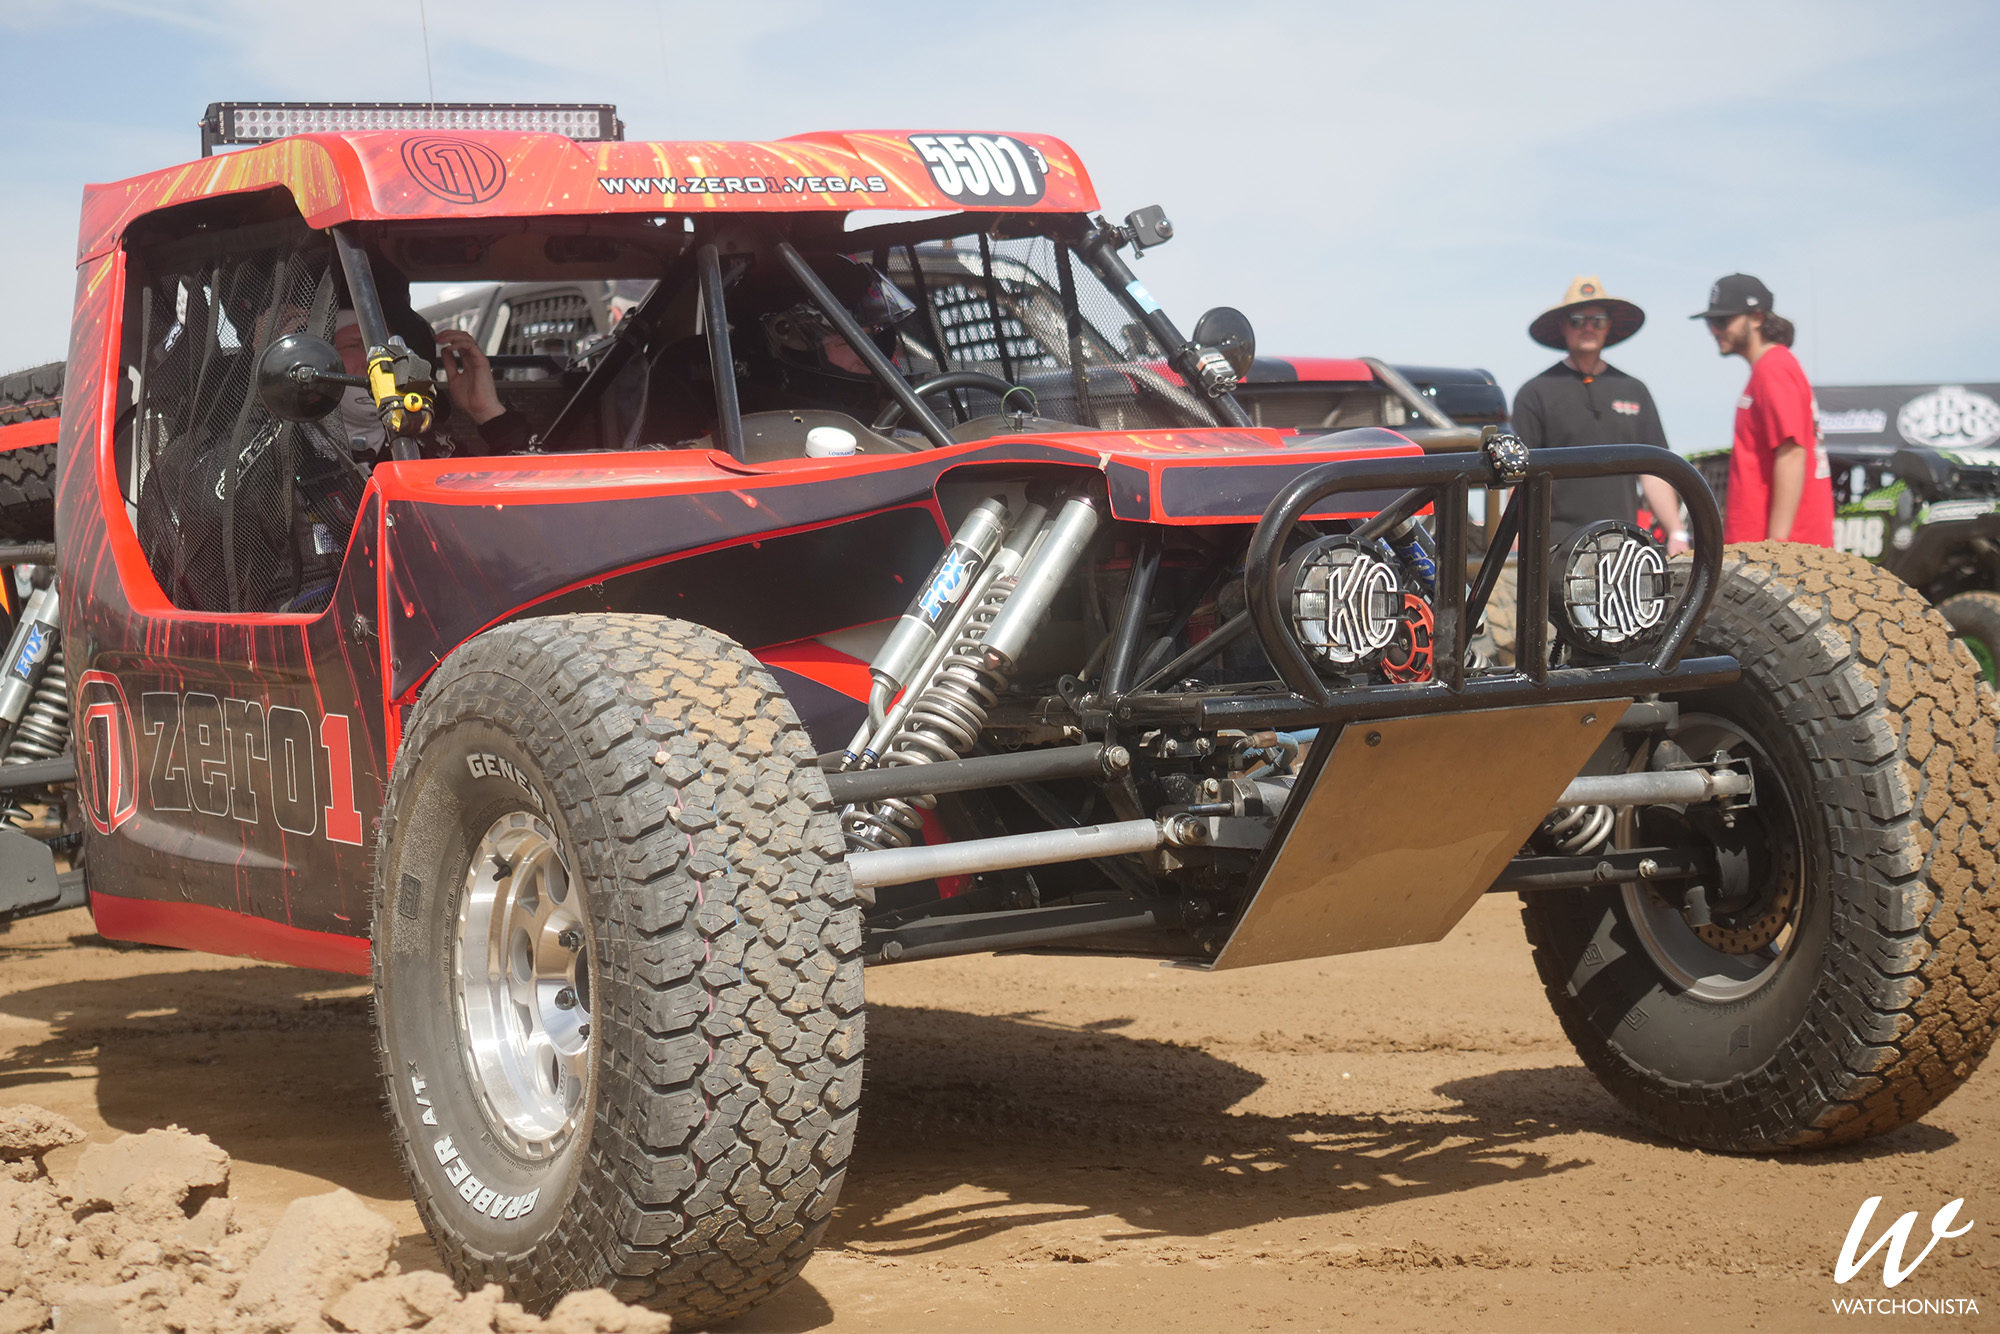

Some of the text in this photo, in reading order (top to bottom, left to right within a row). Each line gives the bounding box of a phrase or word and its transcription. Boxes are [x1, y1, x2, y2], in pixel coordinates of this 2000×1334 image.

[908, 136, 1038, 197] 5501
[918, 547, 965, 624] FOX
[1329, 554, 1398, 654] KC
[1599, 540, 1664, 636] KC
[14, 622, 43, 680] FOX
[433, 1135, 541, 1221] GRABBER
